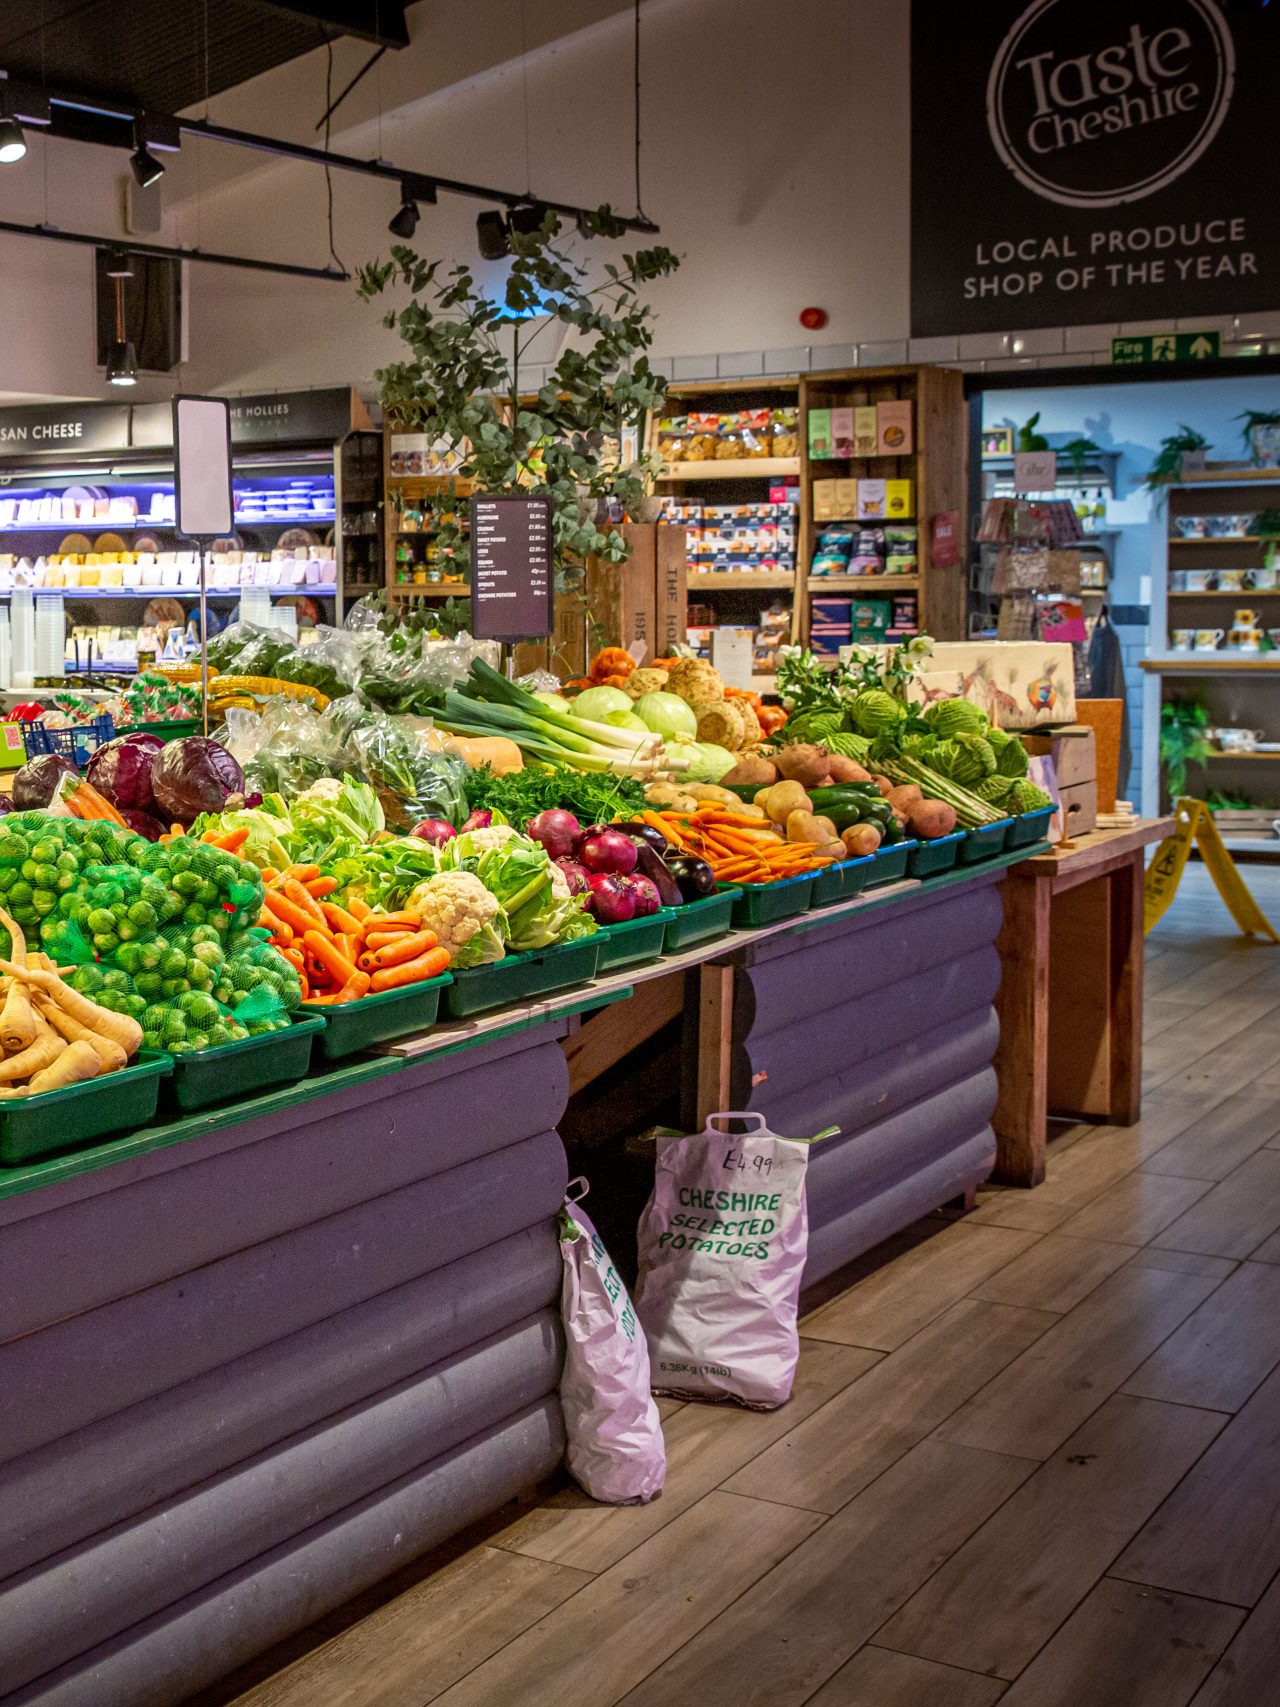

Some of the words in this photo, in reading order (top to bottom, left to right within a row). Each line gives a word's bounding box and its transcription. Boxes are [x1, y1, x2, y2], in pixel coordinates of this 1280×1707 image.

[1016, 24, 1191, 117] Taste
[1028, 82, 1200, 154] Cheshire
[976, 235, 1077, 265] LOCAL
[1091, 218, 1245, 255] PRODUCE
[963, 271, 1043, 299] SHOP
[1056, 266, 1096, 291] OF
[1105, 260, 1165, 287] THE
[1175, 252, 1258, 280] YEAR
[1115, 342, 1143, 354] Fire
[230, 408, 241, 418] HE
[246, 404, 289, 417] HOLLIES
[32, 422, 83, 440] CHEESE
[667, 568, 677, 603] THE
[722, 1149, 773, 1176] £4.99
[679, 1187, 782, 1212] CHESHIRE
[670, 1213, 775, 1237] SELECTED
[658, 1232, 769, 1260] POTATOES
